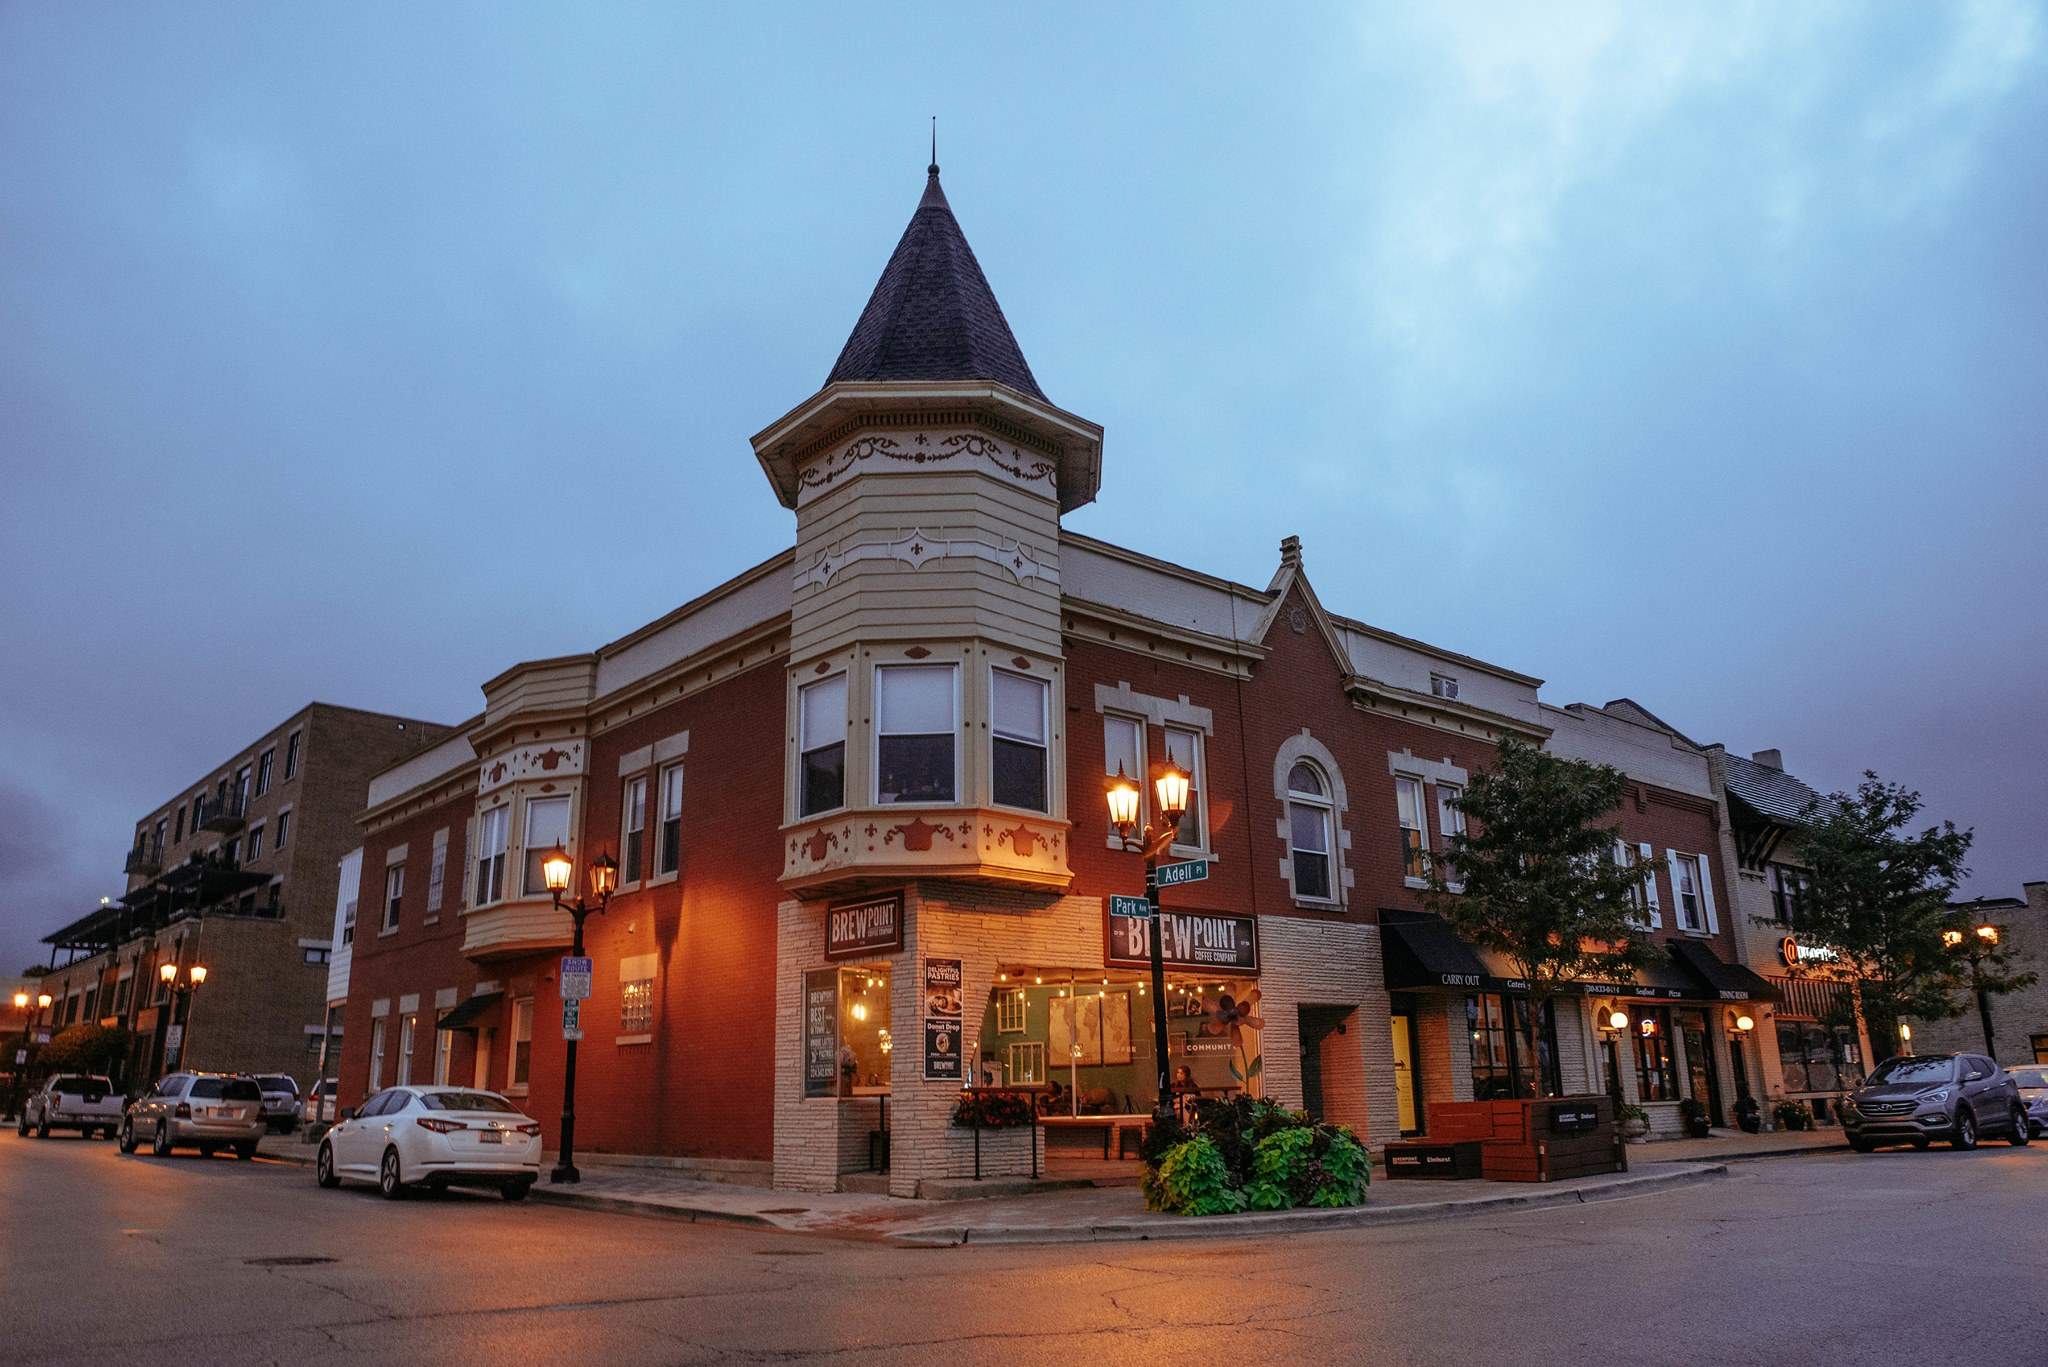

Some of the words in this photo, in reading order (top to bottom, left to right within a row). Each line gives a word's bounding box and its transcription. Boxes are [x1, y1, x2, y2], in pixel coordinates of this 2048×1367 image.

[1165, 864, 1192, 882] Adell
[1196, 865, 1203, 874] Pl
[1116, 898, 1136, 914] Park
[1138, 905, 1147, 913] Ave
[1194, 950, 1213, 962] COFFEE
[1213, 951, 1237, 963] COMPANY
[927, 966, 960, 975] DELIGHTFUL
[927, 972, 960, 981] PASTRIES
[1441, 973, 1464, 985] CARRY
[1464, 975, 1480, 986] OUT
[1635, 987, 1655, 997] Seafood
[810, 1007, 825, 1023] BEST
[927, 1022, 945, 1030] Donut
[945, 1023, 960, 1032] Drop
